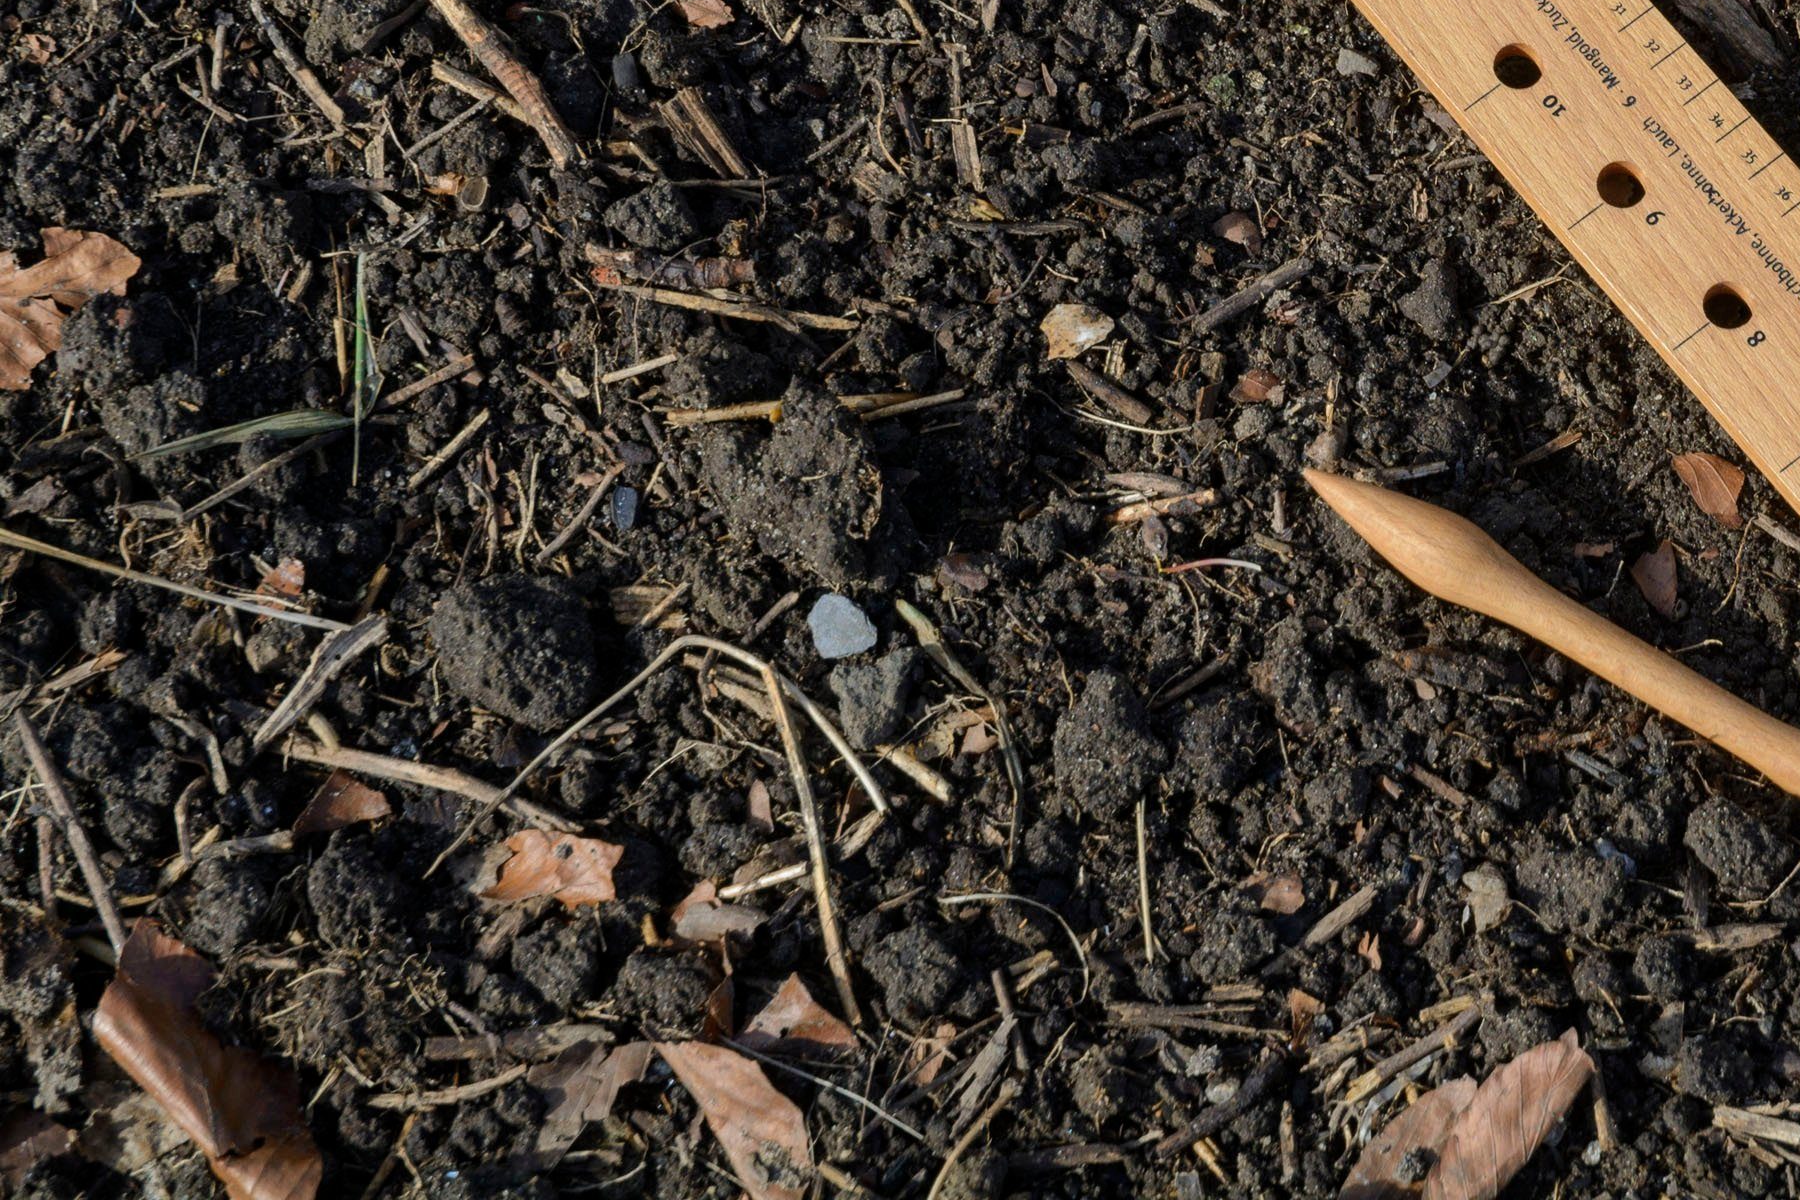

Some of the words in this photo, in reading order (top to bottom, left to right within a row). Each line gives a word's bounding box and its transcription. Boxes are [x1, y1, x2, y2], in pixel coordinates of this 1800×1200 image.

[1563, 25, 1622, 91] Mangold,
[1541, 93, 1568, 118] 10
[1609, 0, 1628, 17] 31
[1642, 37, 1661, 55] 32
[1674, 73, 1694, 92] 33
[1707, 110, 1726, 129] 34
[1740, 147, 1759, 166] 35
[1773, 185, 1793, 202] 36
[1620, 94, 1638, 108] 6
[1641, 115, 1682, 159] Lauch
[1644, 210, 1667, 227] 9
[1746, 329, 1768, 348] 8
